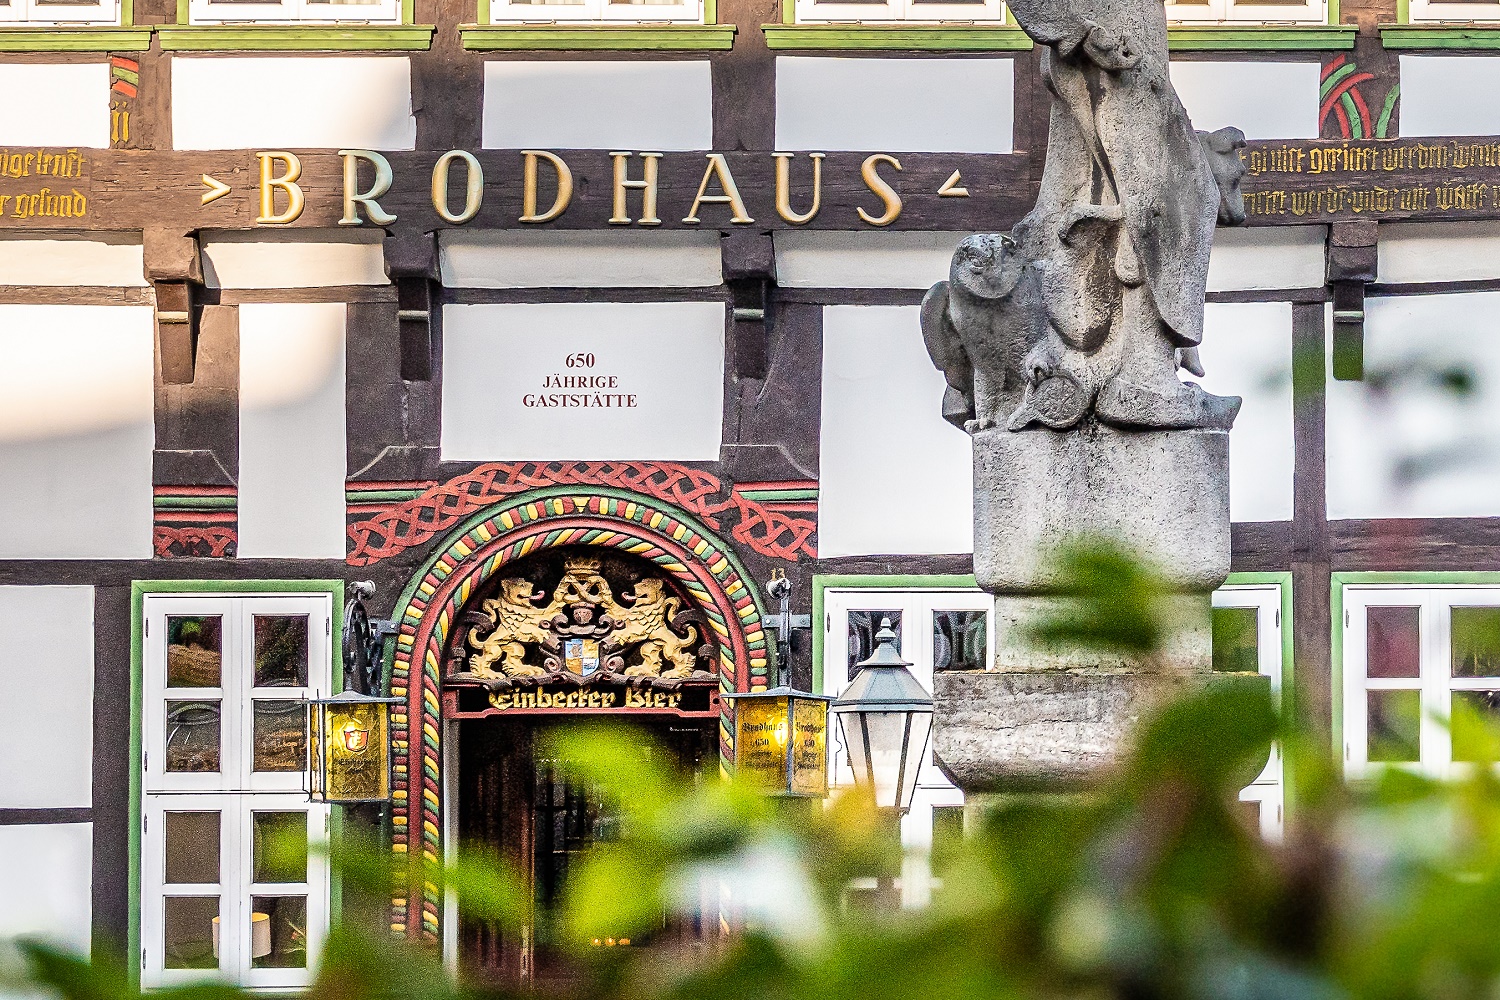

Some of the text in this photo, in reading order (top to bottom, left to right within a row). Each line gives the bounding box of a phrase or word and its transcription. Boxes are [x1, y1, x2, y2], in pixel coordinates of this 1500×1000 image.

[255, 149, 903, 227] BRODHAUS
[565, 353, 596, 368] 650
[543, 373, 618, 389] JÄHRIGE
[522, 391, 638, 408] GASTSTÄTTE
[625, 685, 682, 708] Bier
